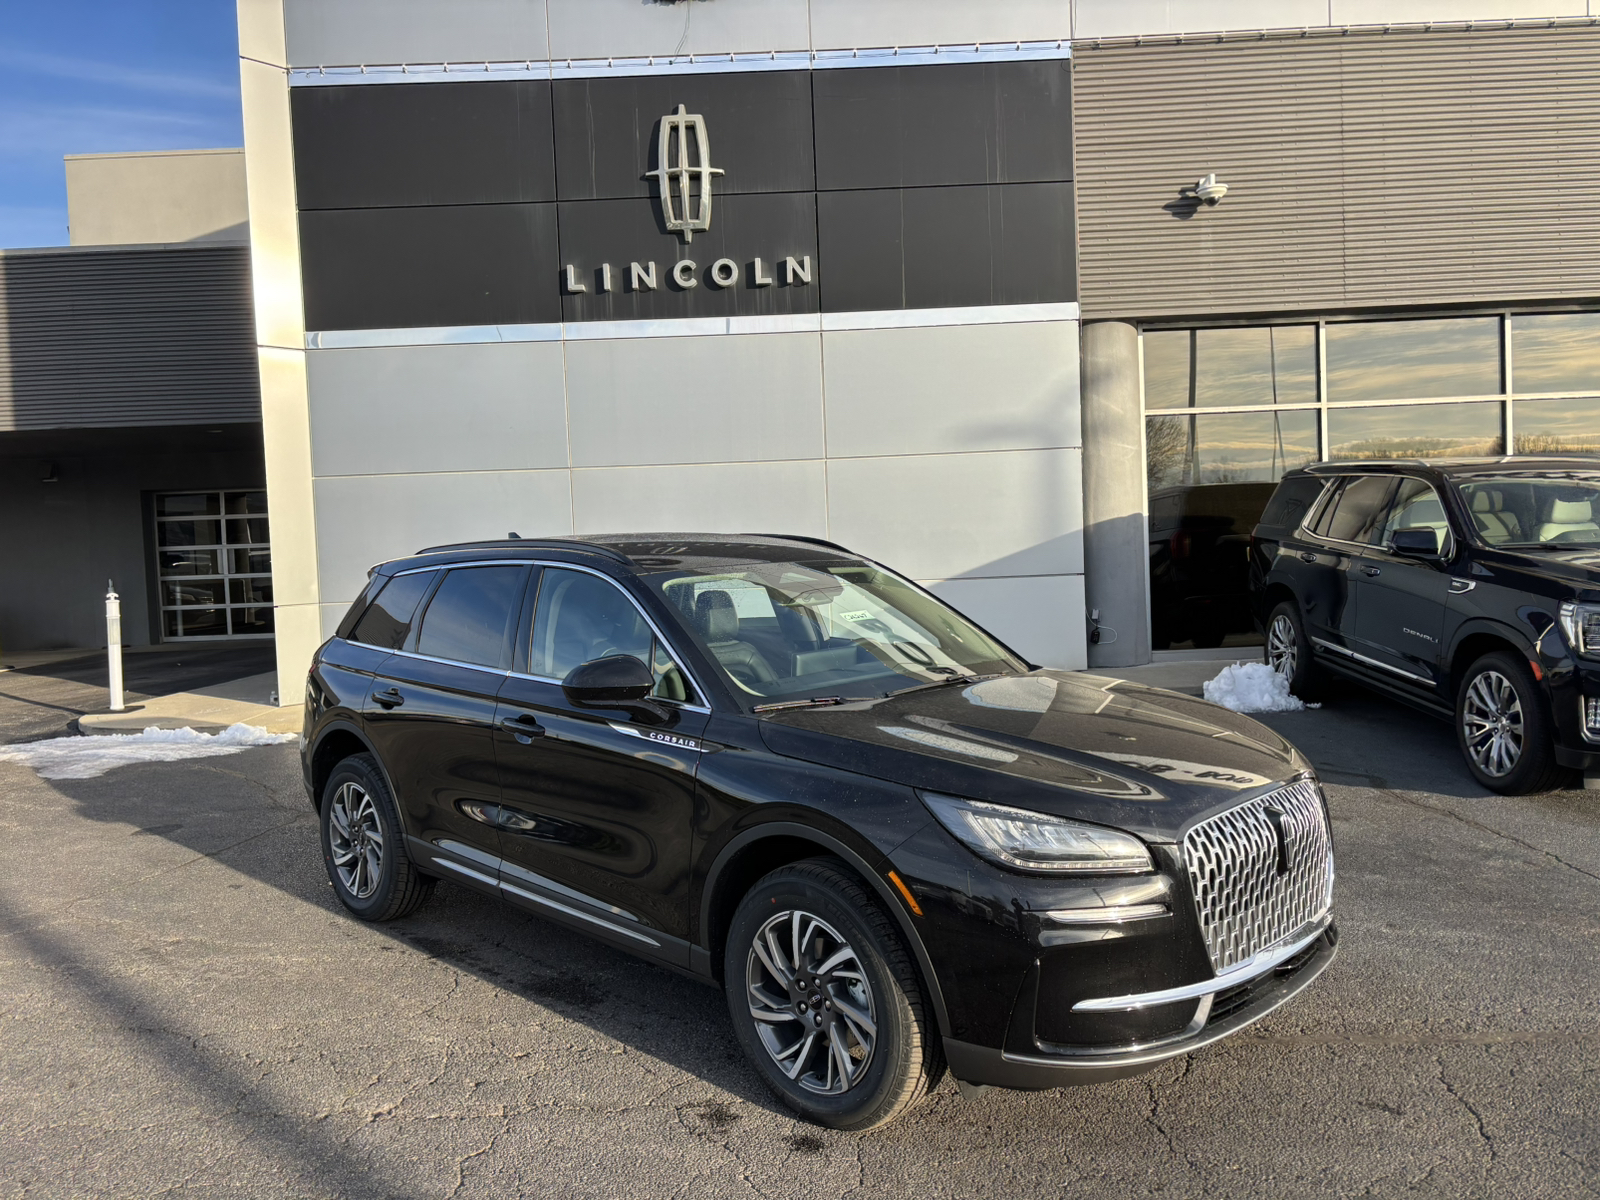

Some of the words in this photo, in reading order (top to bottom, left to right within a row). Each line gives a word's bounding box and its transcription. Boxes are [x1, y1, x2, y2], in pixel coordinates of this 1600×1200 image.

[566, 255, 812, 293] LINCOLN
[1403, 627, 1439, 643] DENALI
[649, 732, 696, 747] CORSAIR
